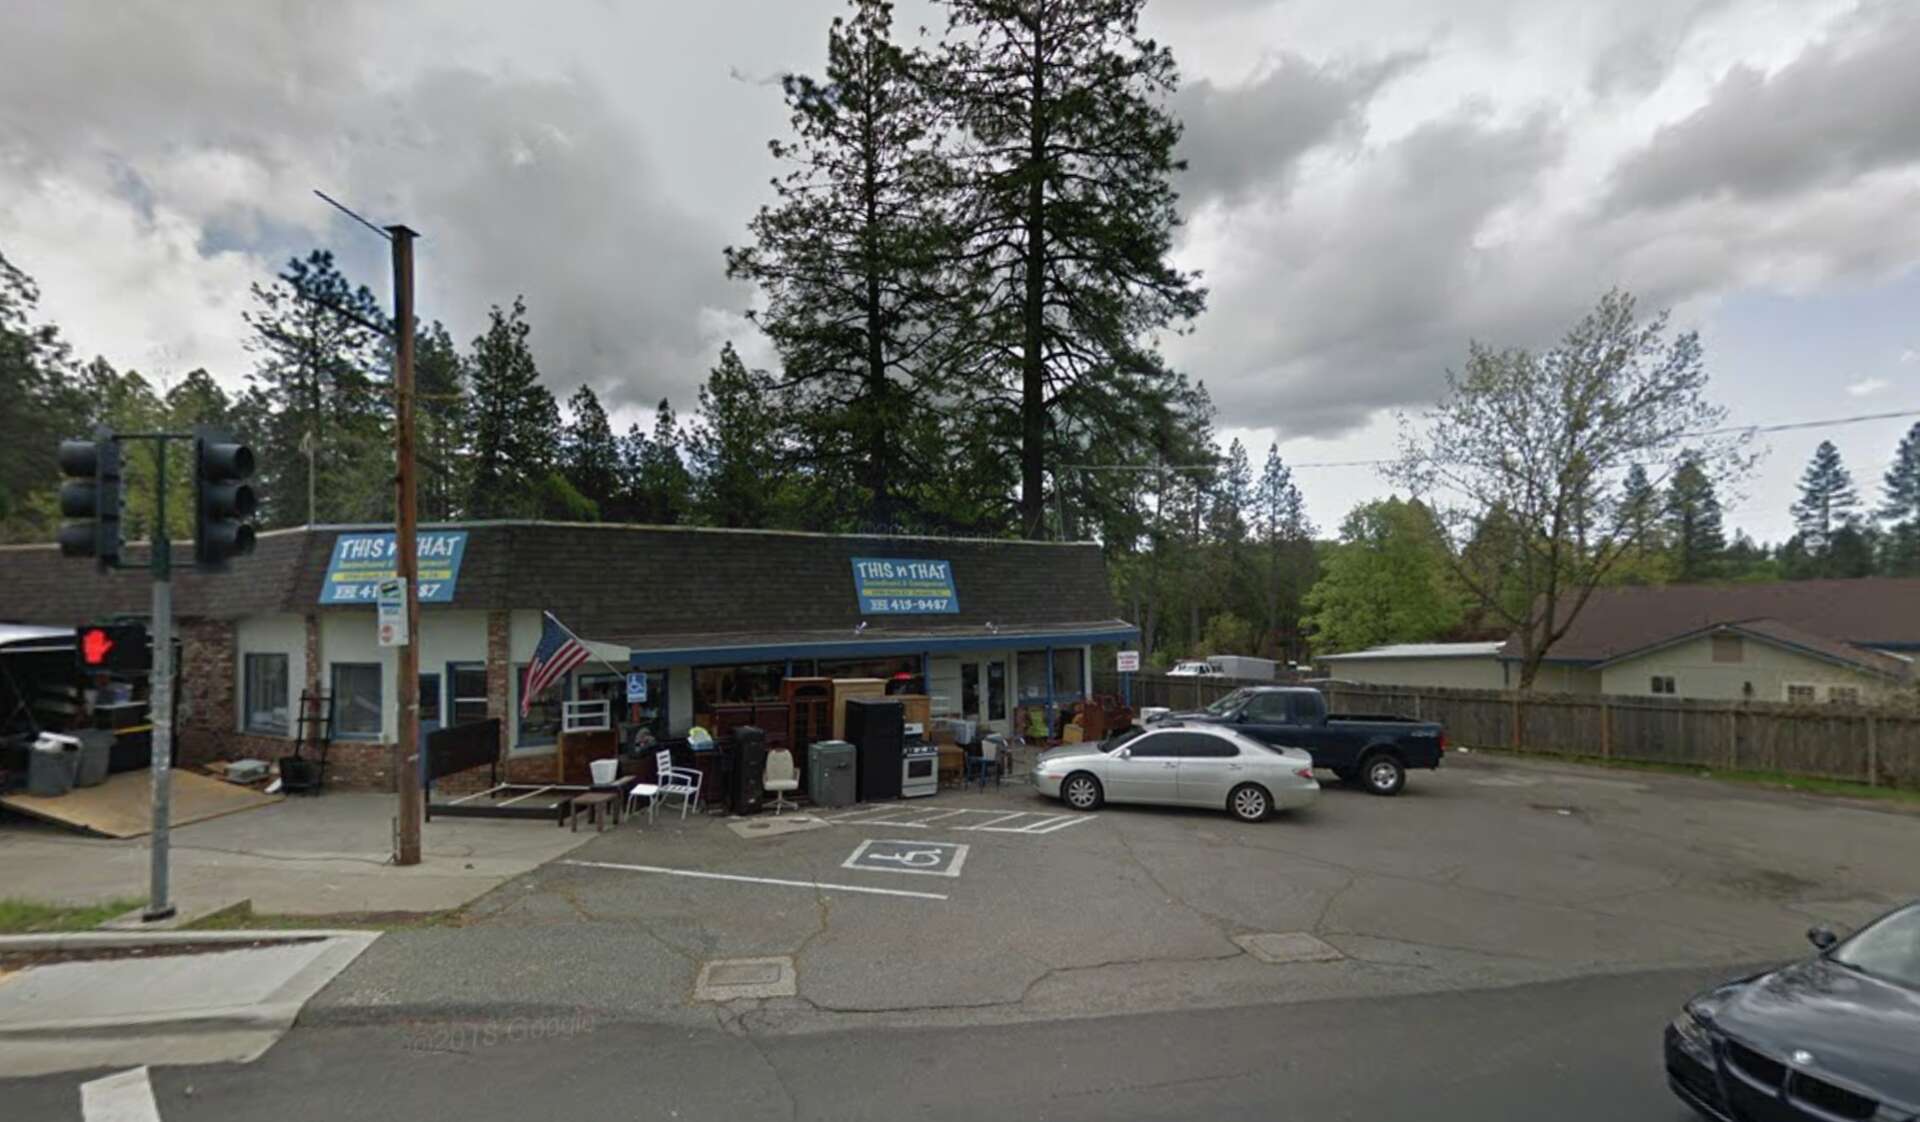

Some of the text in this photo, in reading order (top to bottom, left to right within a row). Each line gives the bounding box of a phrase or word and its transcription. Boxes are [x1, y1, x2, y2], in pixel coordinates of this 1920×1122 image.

[339, 537, 385, 559] THIS
[416, 536, 461, 557] HAT
[857, 561, 894, 579] THIS
[908, 563, 947, 580] THAT
